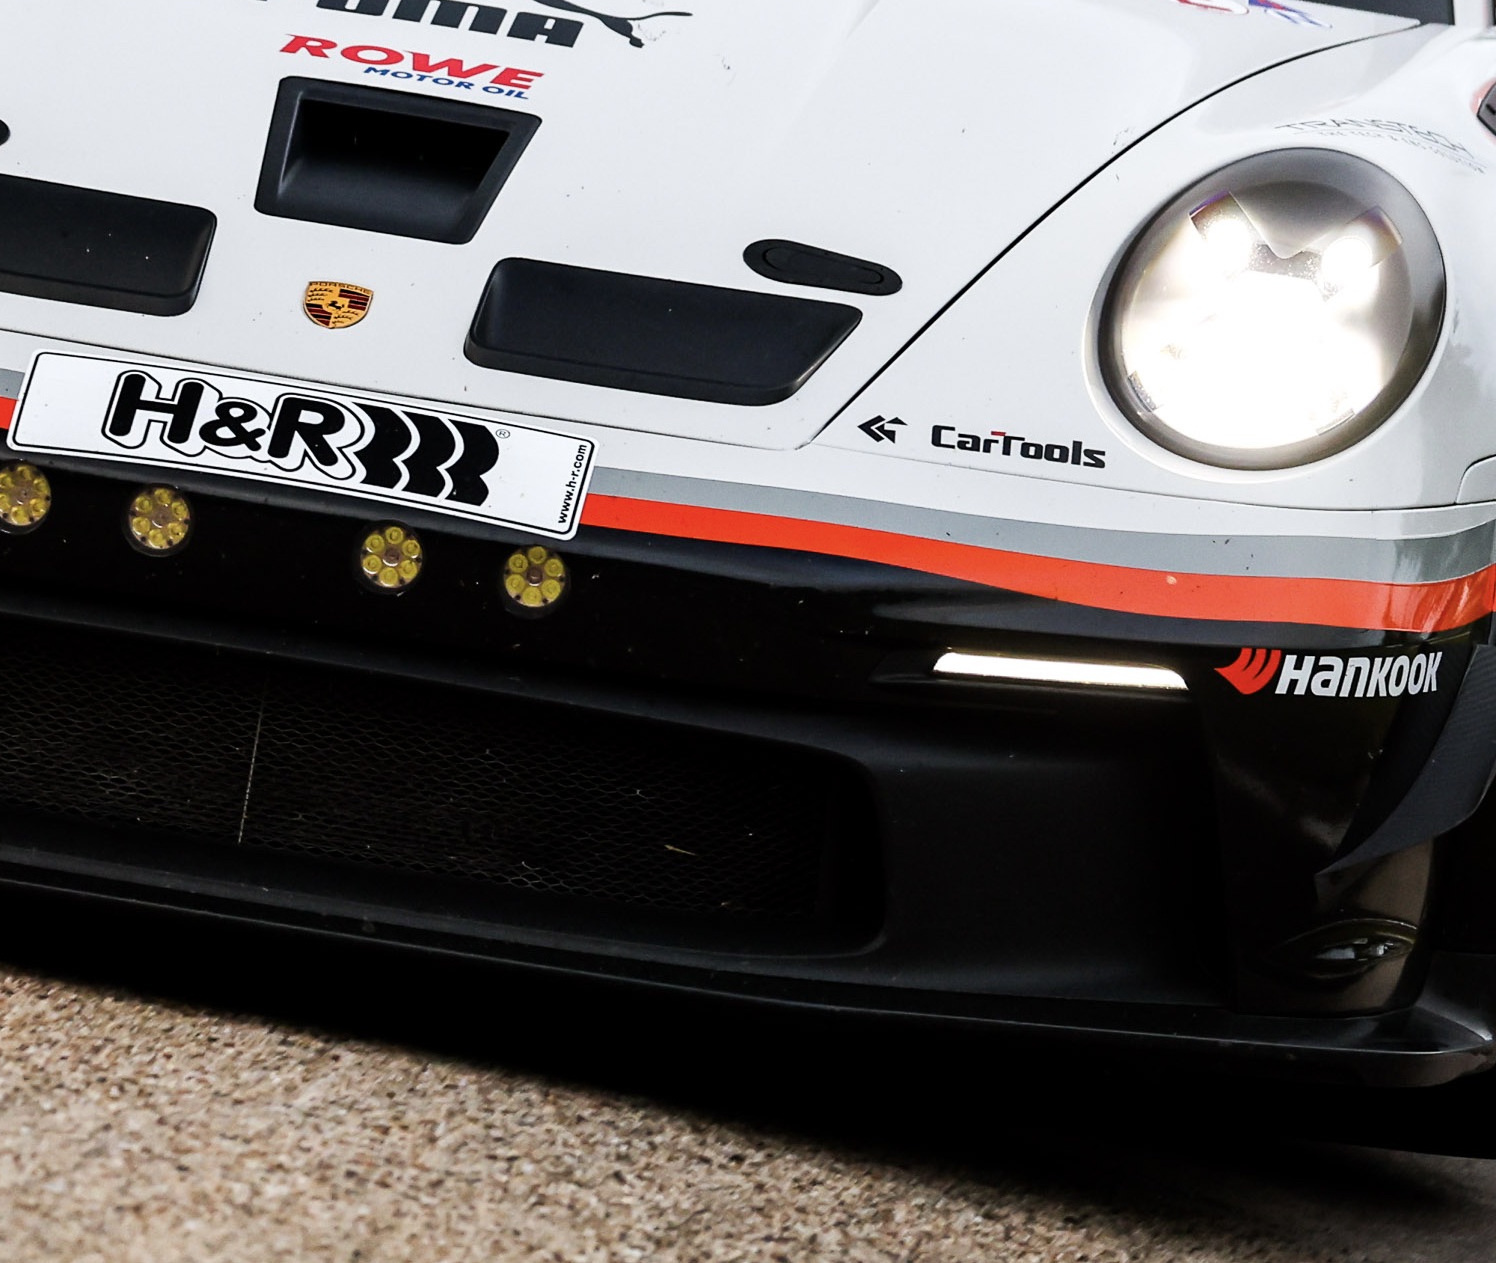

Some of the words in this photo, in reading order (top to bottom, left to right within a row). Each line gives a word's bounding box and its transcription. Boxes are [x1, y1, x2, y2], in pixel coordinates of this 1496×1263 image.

[279, 33, 545, 90] ROWE
[363, 66, 474, 90] MOTOR
[481, 85, 529, 100] OIL
[105, 371, 354, 473] H&R
[931, 424, 1106, 469] CarTools
[558, 444, 587, 524] www.h-r.com
